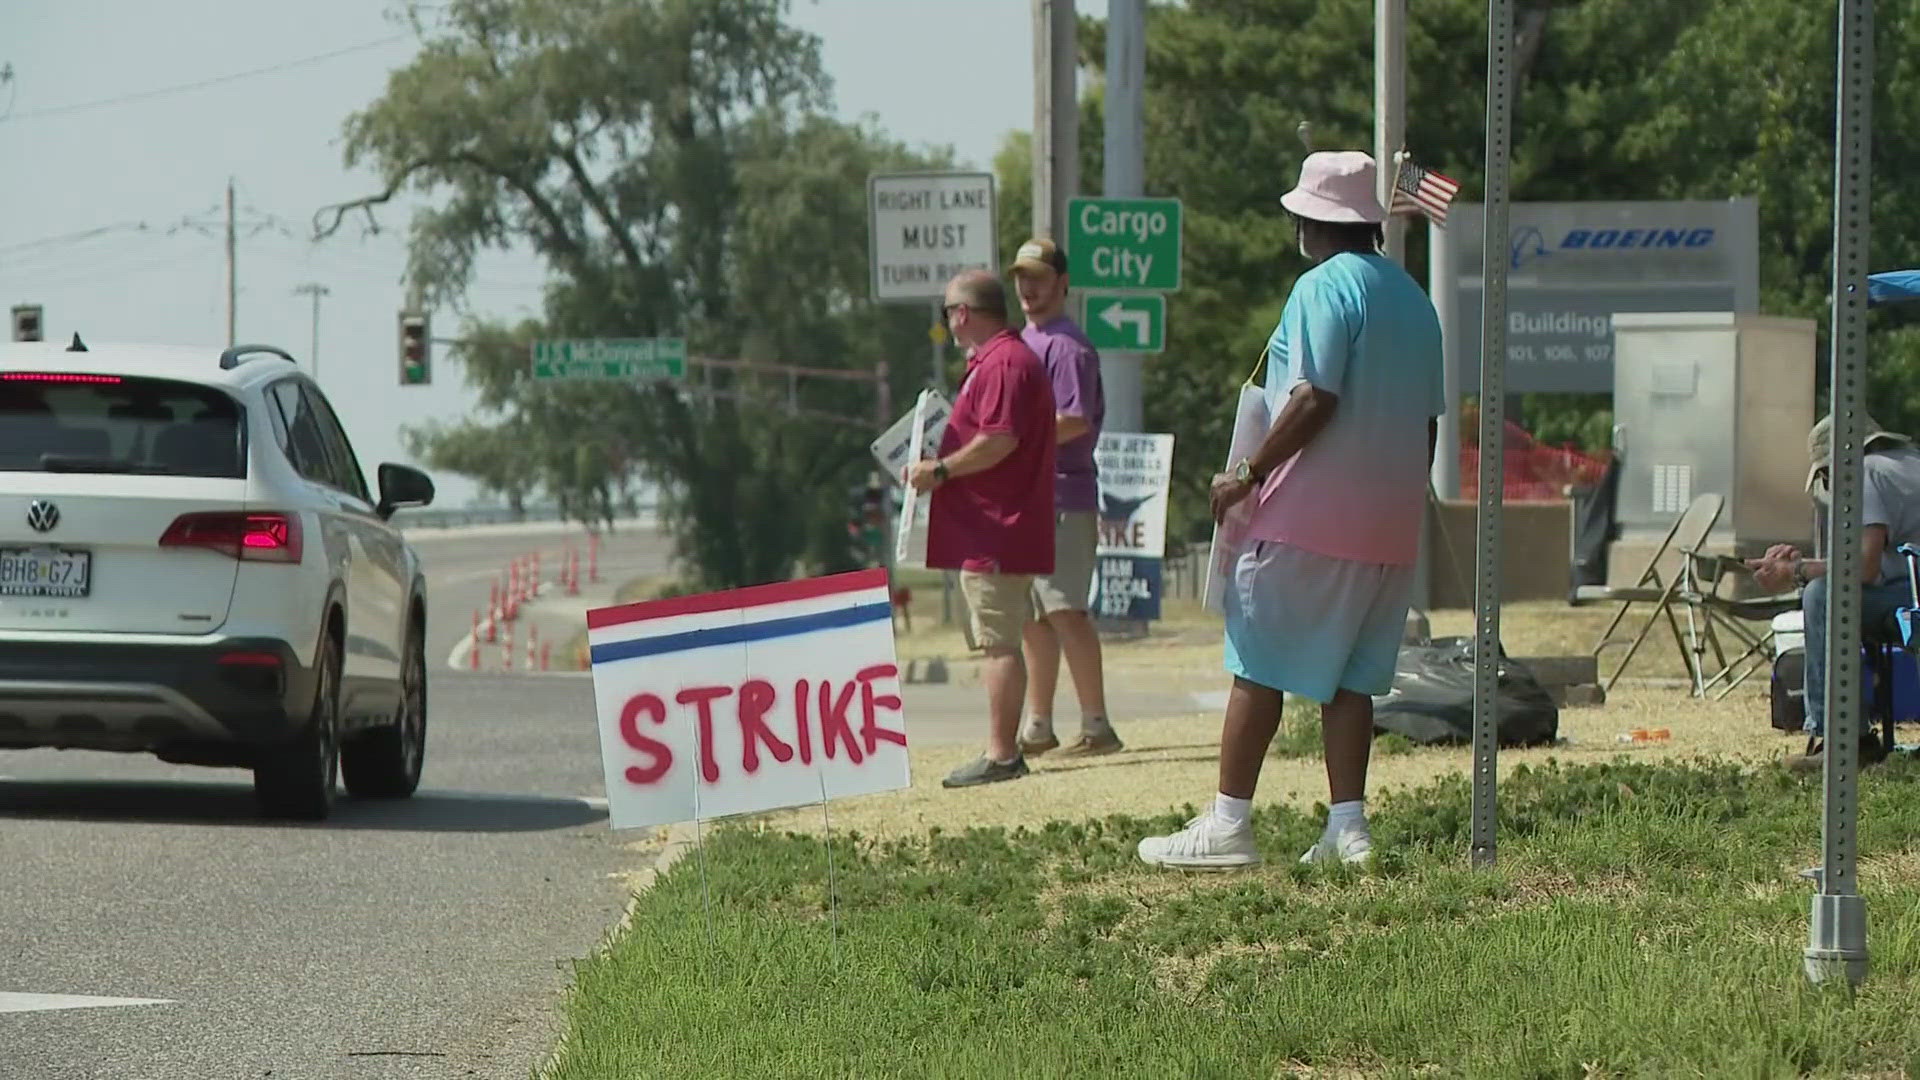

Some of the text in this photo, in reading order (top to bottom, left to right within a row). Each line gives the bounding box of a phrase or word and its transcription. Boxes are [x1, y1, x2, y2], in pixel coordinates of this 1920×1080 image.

[878, 190, 986, 210] RIGHT LANE
[1081, 204, 1167, 243] Cargo
[902, 224, 967, 249] MUST
[1560, 228, 1715, 248] BOEING
[882, 263, 930, 284] TURN
[1092, 246, 1153, 285] City
[1102, 578, 1152, 599] LOCAL
[618, 663, 907, 785] STRIKE
